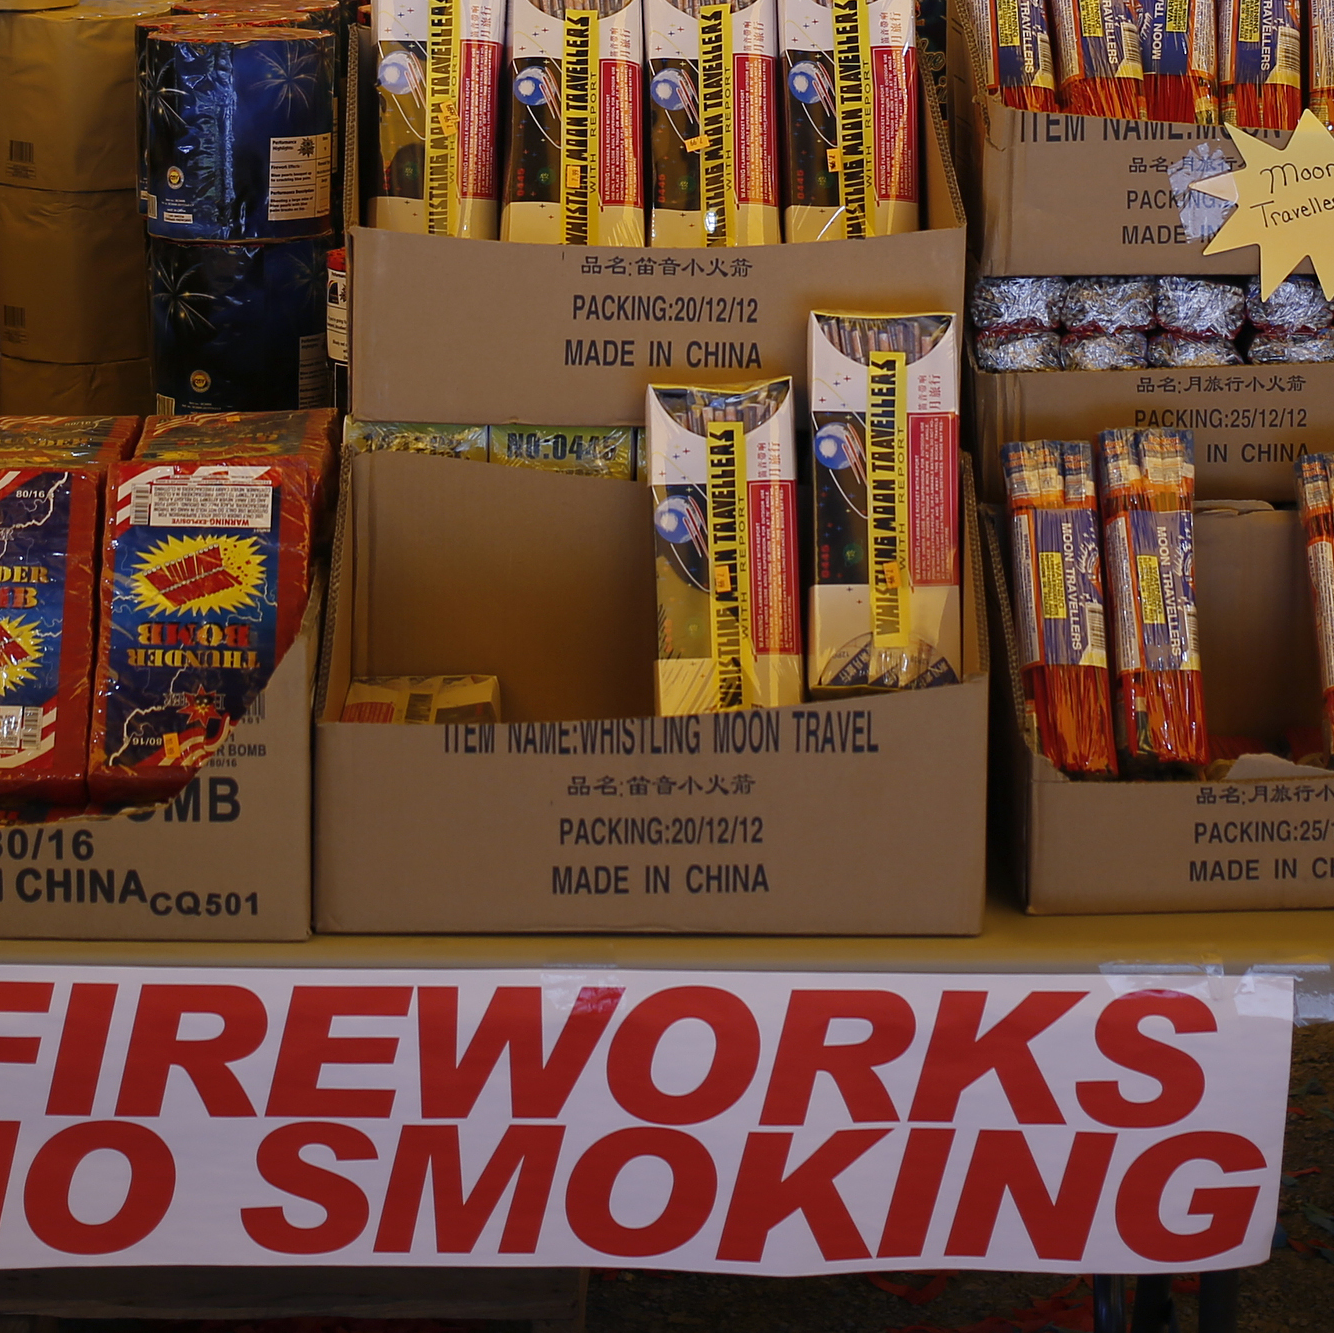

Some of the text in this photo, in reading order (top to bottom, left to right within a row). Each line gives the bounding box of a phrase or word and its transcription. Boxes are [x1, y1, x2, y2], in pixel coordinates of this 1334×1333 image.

[1152, 24, 1162, 60] MOON
[581, 256, 752, 279] 品名:笛音小火箭
[572, 295, 758, 324] PACKING:20/12/12
[564, 340, 761, 369] MADE IN CHINA
[1135, 376, 1307, 395] 品名:月旅行小火箭
[1133, 408, 1308, 430] PACKING:25/12/12
[1206, 442, 1310, 463] IN CHINA
[16, 490, 45, 498] 80/16
[897, 427, 906, 569] WITH REPORT
[738, 495, 746, 573] REPORT
[1062, 522, 1082, 651] MOON TRAVELLERS
[1156, 526, 1182, 657] MOON TRAVELLERS
[138, 622, 250, 644] BOMB
[128, 647, 259, 668] THUNDER
[444, 724, 495, 754] ITEM
[713, 711, 780, 754] MOON
[795, 710, 879, 754] TRAVEL
[228, 744, 266, 756] BOMB
[567, 774, 756, 797] 品名:笛音小火箭
[559, 816, 764, 845] PACKING:20/12/12
[551, 864, 769, 895] MADE IN CHINA
[1188, 859, 1262, 883] MADE
[1274, 859, 1298, 881] IN
[16, 869, 147, 903] CHINA
[149, 892, 260, 917] CQ501
[238, 1121, 1269, 1263] SMOKING
